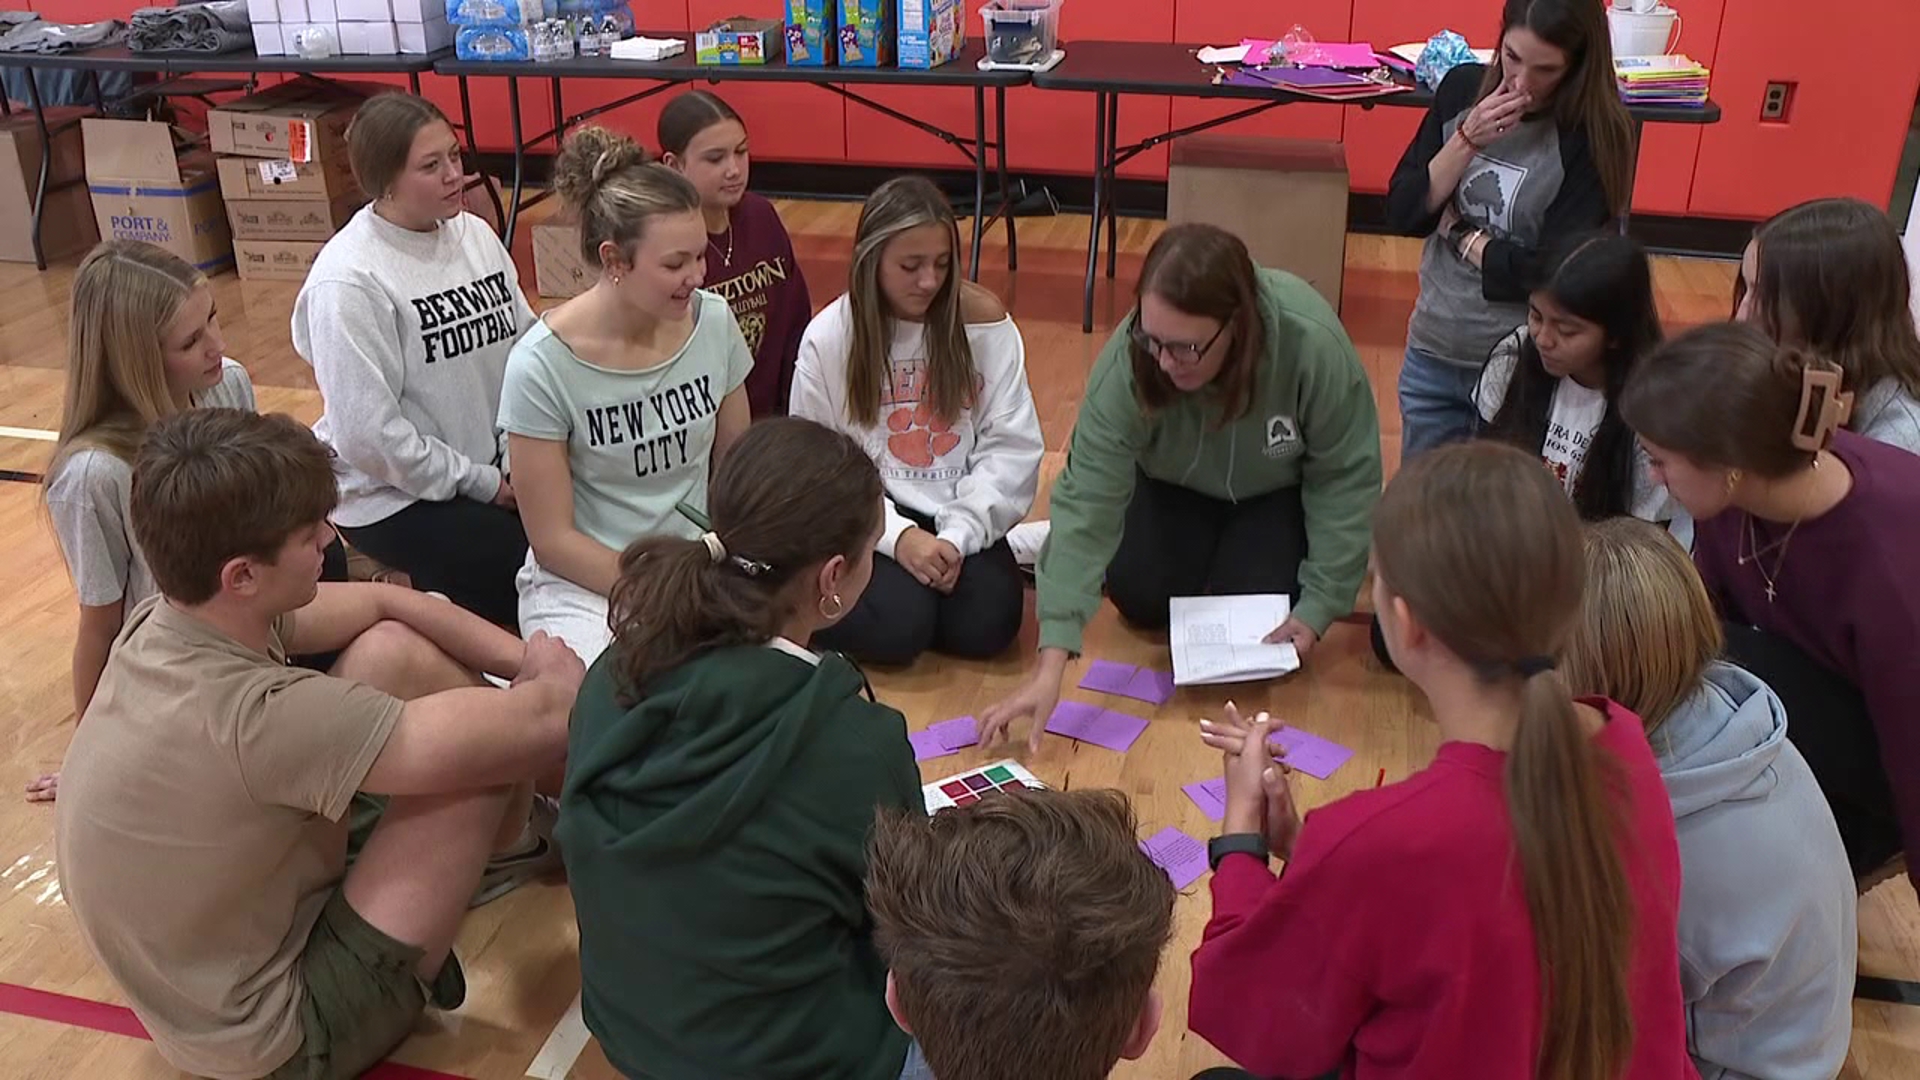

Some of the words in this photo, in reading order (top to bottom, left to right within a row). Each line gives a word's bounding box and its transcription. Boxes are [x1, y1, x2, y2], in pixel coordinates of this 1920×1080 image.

[111, 216, 153, 230] PORT
[156, 218, 168, 231] &
[114, 230, 170, 242] COMPANY
[698, 257, 786, 300] TZTOWN
[411, 271, 512, 331] BERWICK
[586, 401, 644, 446] NEW
[650, 375, 716, 431] YORK
[634, 429, 687, 478] CITY
[905, 469, 964, 479] TERRITO
